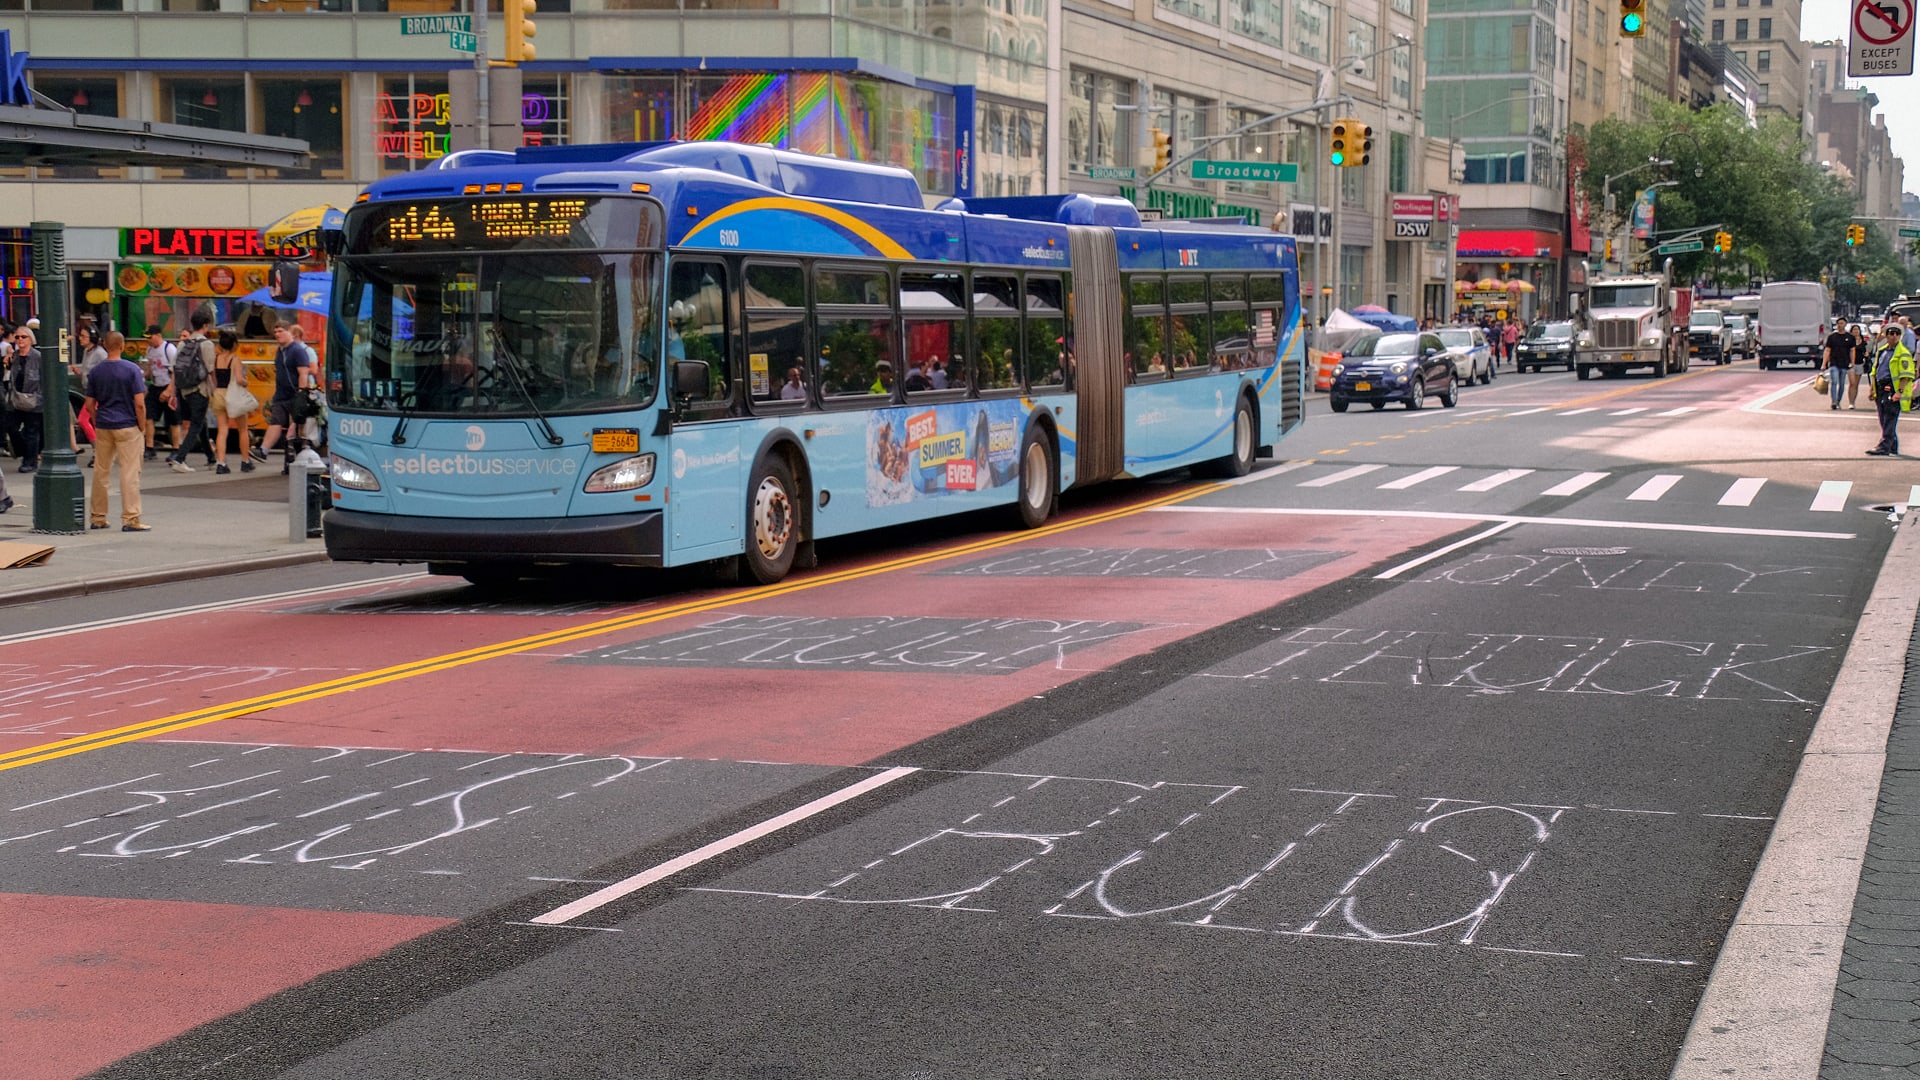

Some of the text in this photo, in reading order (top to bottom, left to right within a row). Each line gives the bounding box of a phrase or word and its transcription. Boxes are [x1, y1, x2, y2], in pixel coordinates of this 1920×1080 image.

[406, 16, 466, 33] BROADWAY
[452, 33, 458, 49] E
[459, 34, 467, 50] 14
[1861, 48, 1901, 58] EXCEPT
[1863, 60, 1898, 70] BUSES
[370, 93, 549, 125] A PRD
[370, 131, 543, 159] WELE
[1093, 168, 1132, 179] BROADWAY
[1206, 164, 1281, 181] Broadway
[719, 229, 739, 247] 6100
[1396, 222, 1429, 236] DSW
[365, 380, 394, 398] 151
[340, 418, 373, 436] 6100
[909, 415, 935, 443] BEST.
[922, 437, 964, 462] SUMMER.
[947, 464, 975, 484] EVER.
[1245, 626, 1833, 703] TRUCK
[800, 775, 1570, 946] BUS
